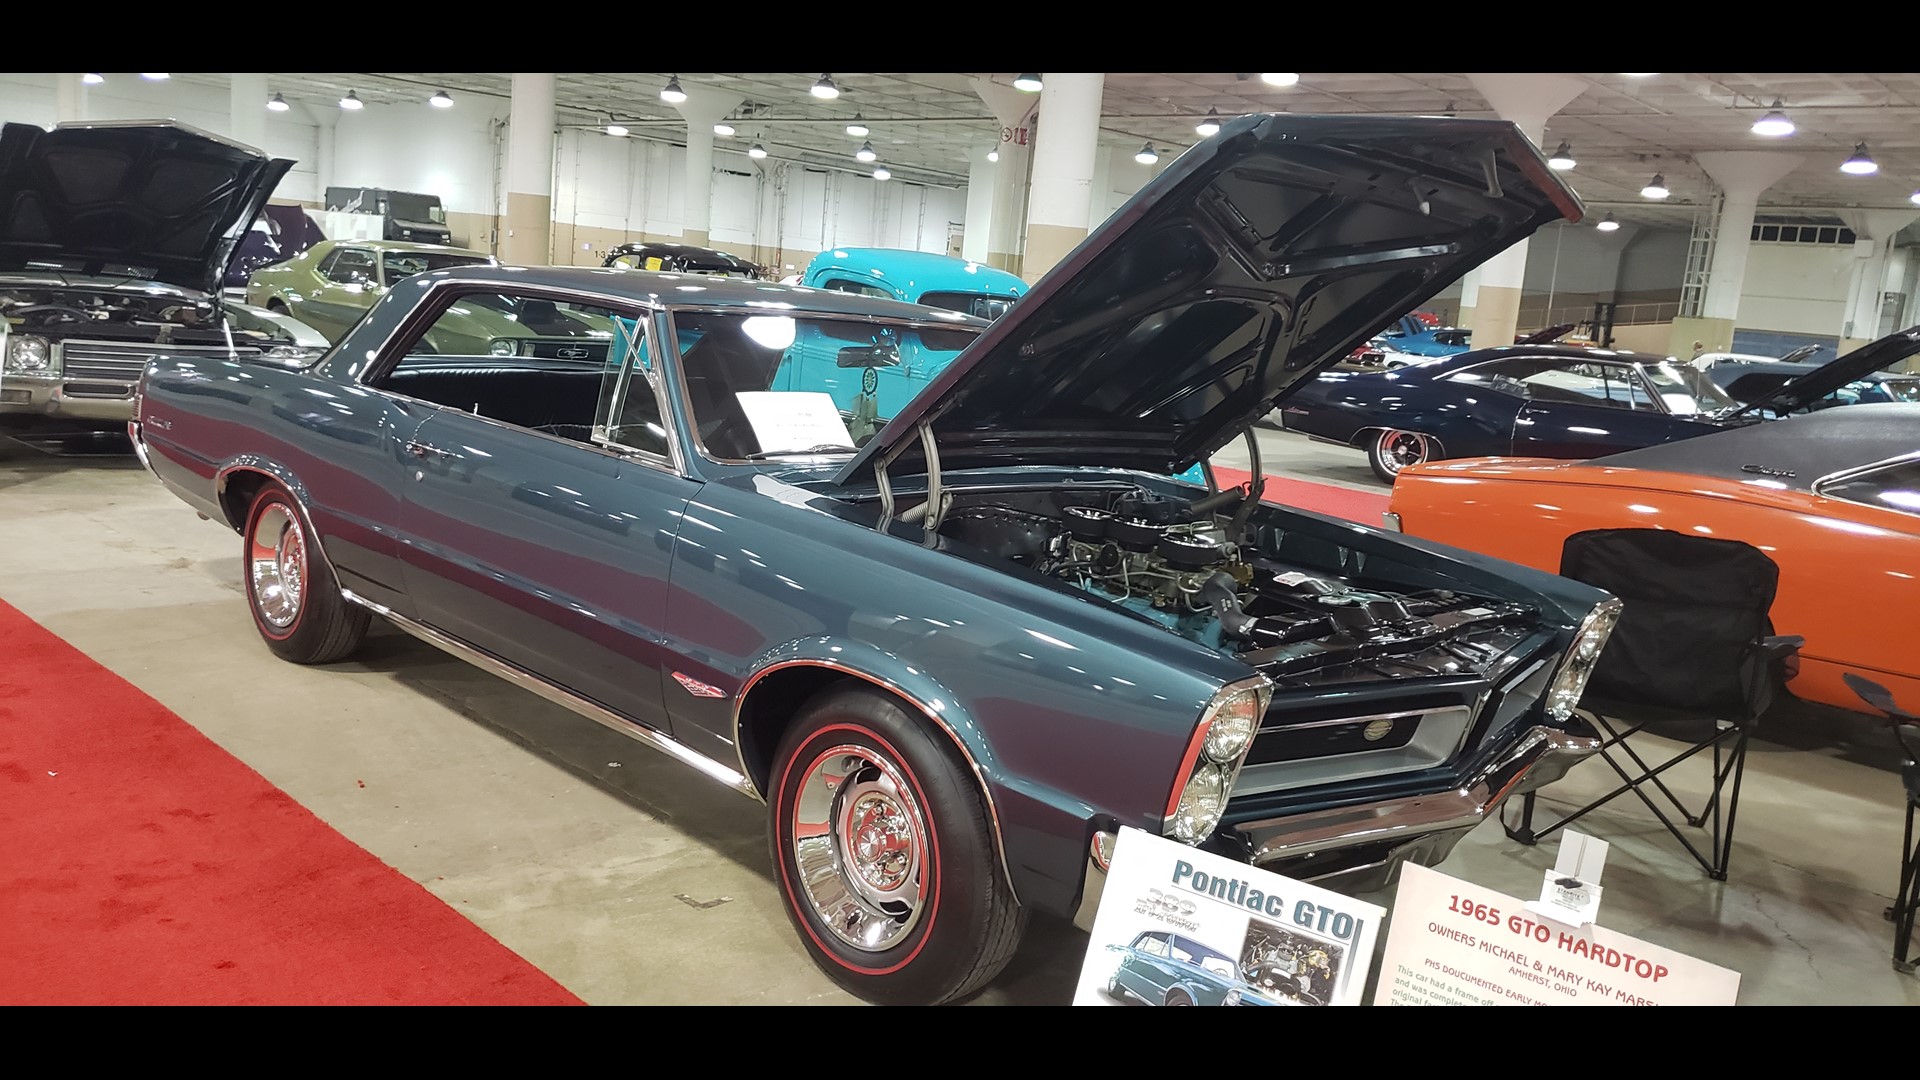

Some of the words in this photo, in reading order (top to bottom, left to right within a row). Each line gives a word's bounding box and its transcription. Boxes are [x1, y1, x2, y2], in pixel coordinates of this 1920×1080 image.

[1172, 859, 1284, 919] Pontiac
[1293, 899, 1355, 941] GTO
[1448, 894, 1501, 926] 1965
[1507, 915, 1551, 943] GTO
[1557, 931, 1669, 983] HARDTOP
[1397, 964, 1413, 977] This
[1415, 973, 1429, 983] car
[1429, 977, 1446, 990] had
[1455, 987, 1479, 1003] frame
[1424, 958, 1440, 970] PHS
[1442, 965, 1503, 994] DOUCUMENTED
[1505, 989, 1532, 1005] EARLY
[1428, 922, 1476, 947] OWNERS
[1479, 940, 1529, 968] MICHAEL
[1532, 959, 1543, 972] &
[1547, 965, 1584, 986] MARY
[1586, 978, 1613, 997] KAY
[1615, 989, 1659, 1006] MARS
[1508, 966, 1551, 989] AMHERST,
[1554, 982, 1577, 997] OHIO
[1392, 988, 1422, 1005] original
[1394, 977, 1410, 988] and
[1411, 984, 1427, 995] was
